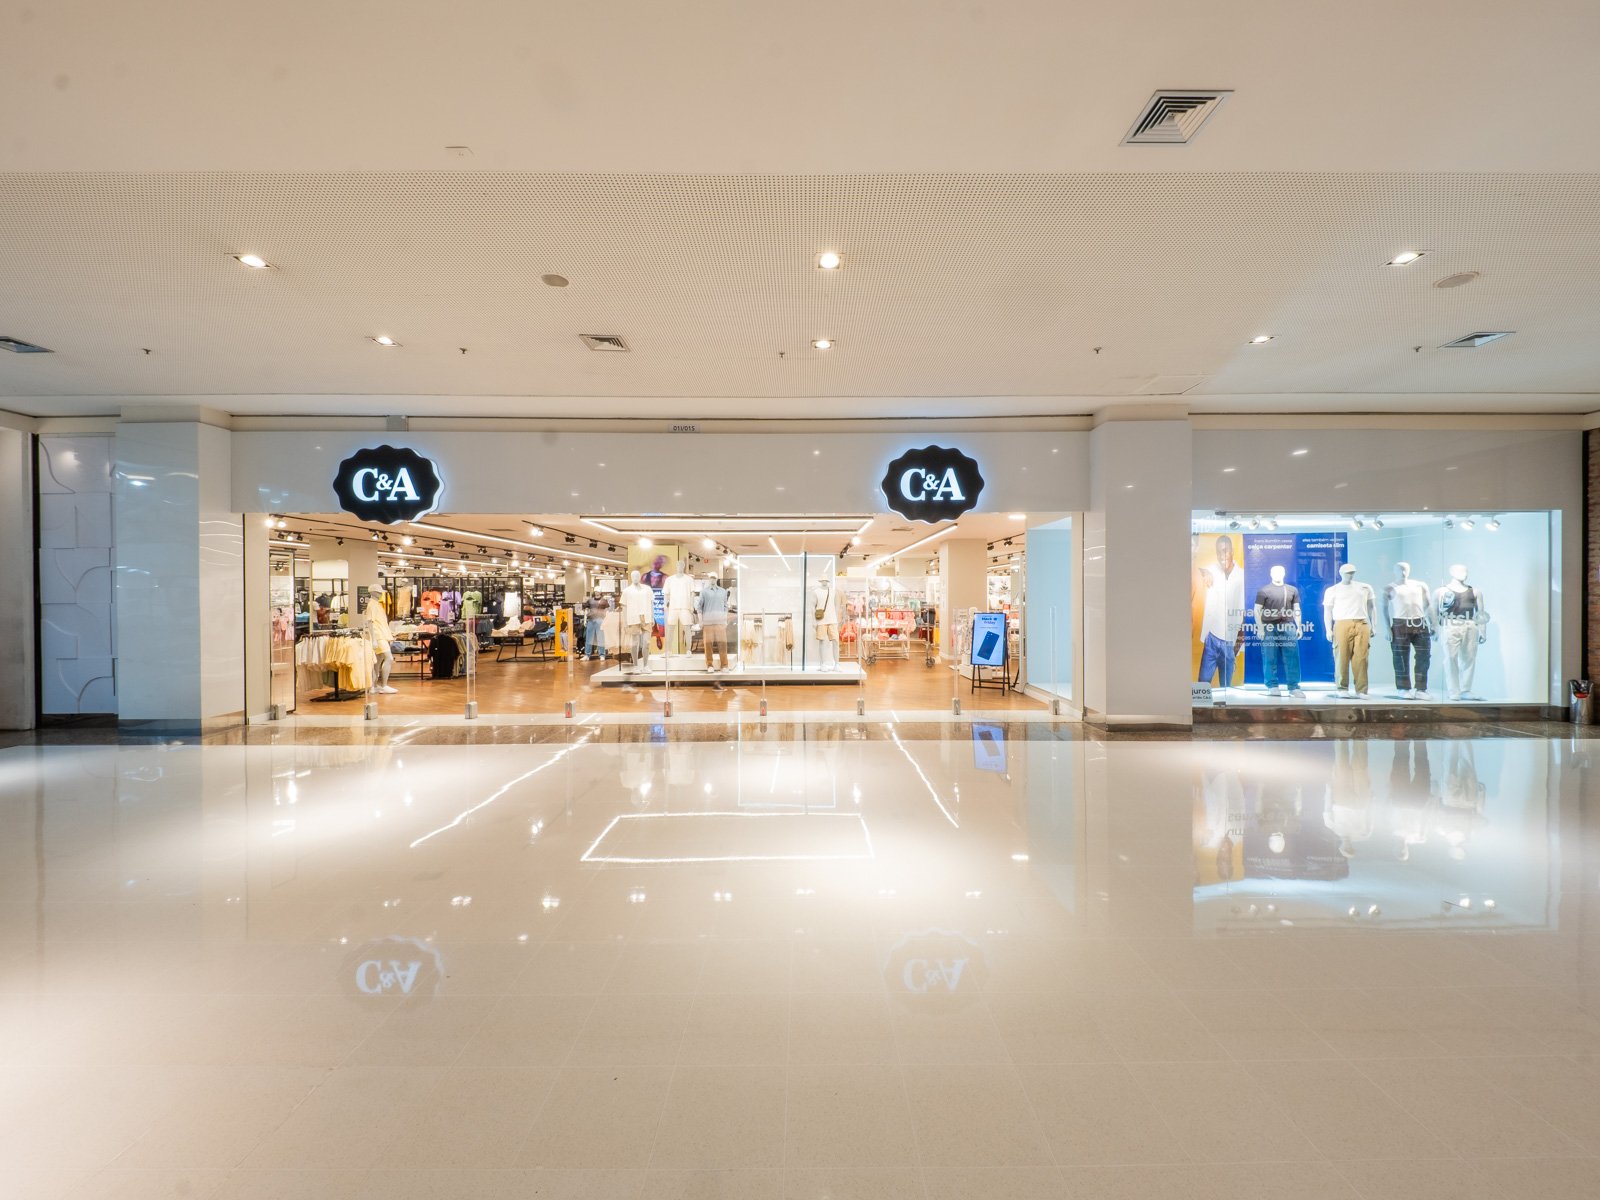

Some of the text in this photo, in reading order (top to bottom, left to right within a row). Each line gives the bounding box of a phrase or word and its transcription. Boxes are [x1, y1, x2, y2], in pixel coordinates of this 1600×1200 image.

[352, 467, 420, 502] C&A
[900, 467, 966, 502] C&A
[1227, 607, 1254, 617] uma
[1227, 622, 1275, 634] sempre
[1191, 687, 1211, 695] juros
